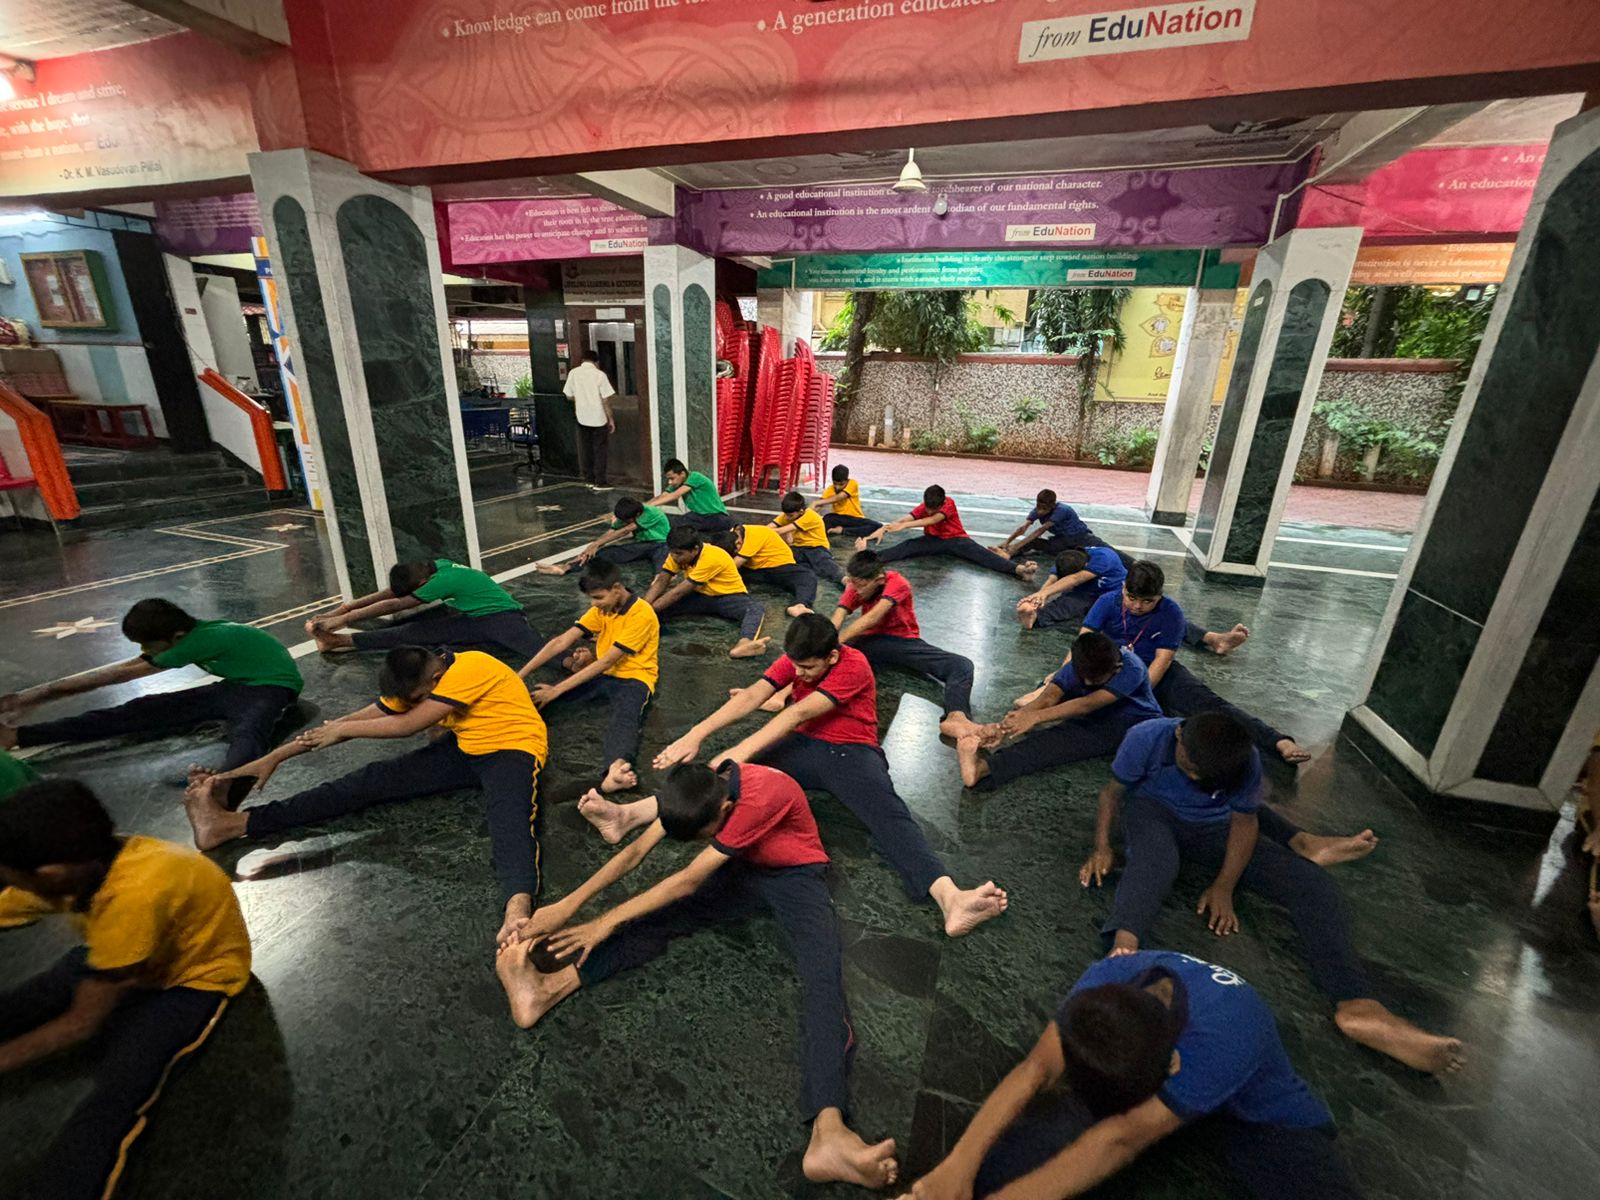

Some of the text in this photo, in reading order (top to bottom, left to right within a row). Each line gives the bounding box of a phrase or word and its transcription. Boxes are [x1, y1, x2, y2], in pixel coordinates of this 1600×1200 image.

[454, 12, 532, 37] Knowledge
[535, 10, 562, 26] can
[565, 4, 607, 20] come
[611, 0, 649, 15] from
[772, 0, 996, 35] A generation educa
[1028, 6, 1243, 58] from EduNation
[1514, 151, 1535, 164] An
[766, 191, 773, 200] A
[774, 190, 794, 202] good
[795, 188, 841, 199] educational
[842, 187, 885, 197] institution
[931, 184, 983, 194] torchbearer
[984, 182, 996, 192] of
[997, 184, 1015, 192] our
[1015, 180, 1053, 191] national
[1055, 179, 1103, 190] character.
[1448, 178, 1467, 190] An
[528, 209, 559, 217] Education
[756, 199, 1099, 218] An educational institution is the most ardent odian of our fundamental rights.
[464, 233, 494, 242] Education
[505, 232, 515, 240] the
[515, 232, 533, 241] power
[571, 228, 593, 238] change
[594, 227, 607, 235] and
[1032, 226, 1091, 237] EduNation
[608, 240, 648, 249] EduNation
[1088, 269, 1133, 279] EduNation
